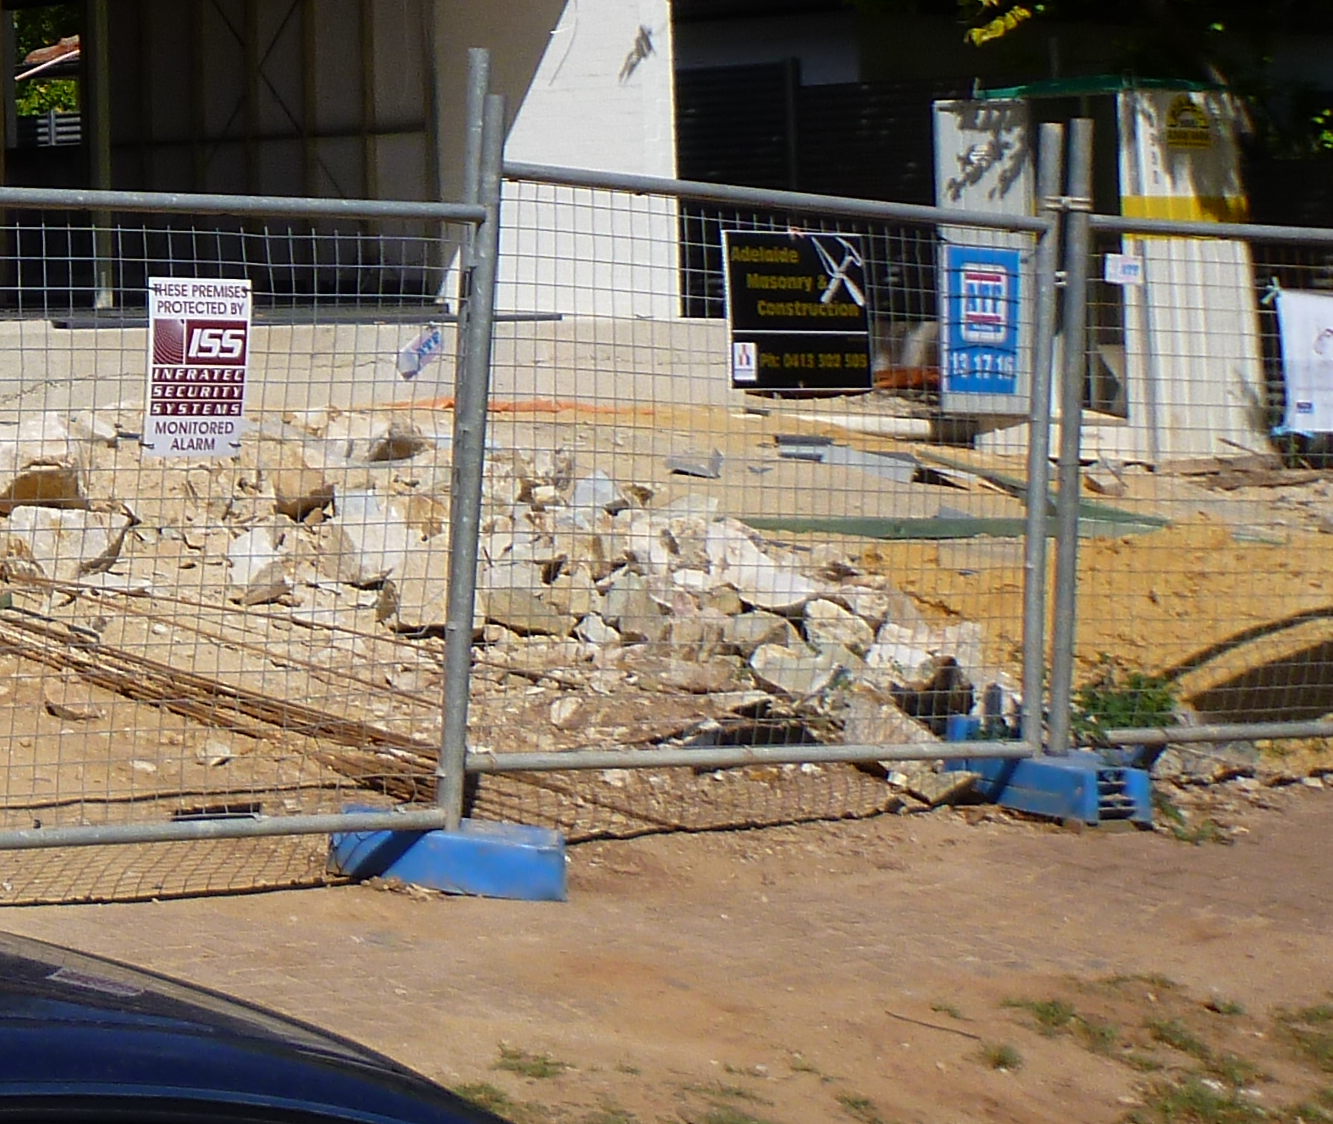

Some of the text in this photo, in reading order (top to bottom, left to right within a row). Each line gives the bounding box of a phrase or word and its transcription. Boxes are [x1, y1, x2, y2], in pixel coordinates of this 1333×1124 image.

[731, 246, 799, 263] Adelaide
[746, 273, 812, 292] Masonry
[154, 283, 247, 299] THESE PREMISES
[157, 301, 244, 315] PROTECTED BY
[757, 300, 859, 316] Construction
[188, 328, 245, 358] ISS
[974, 353, 992, 379] 17
[153, 368, 243, 381] INFRATEC
[152, 386, 243, 398] SECURITY
[152, 402, 240, 415] SYSTEMS
[155, 421, 234, 435] MONITORED
[170, 437, 215, 451] ALARM
